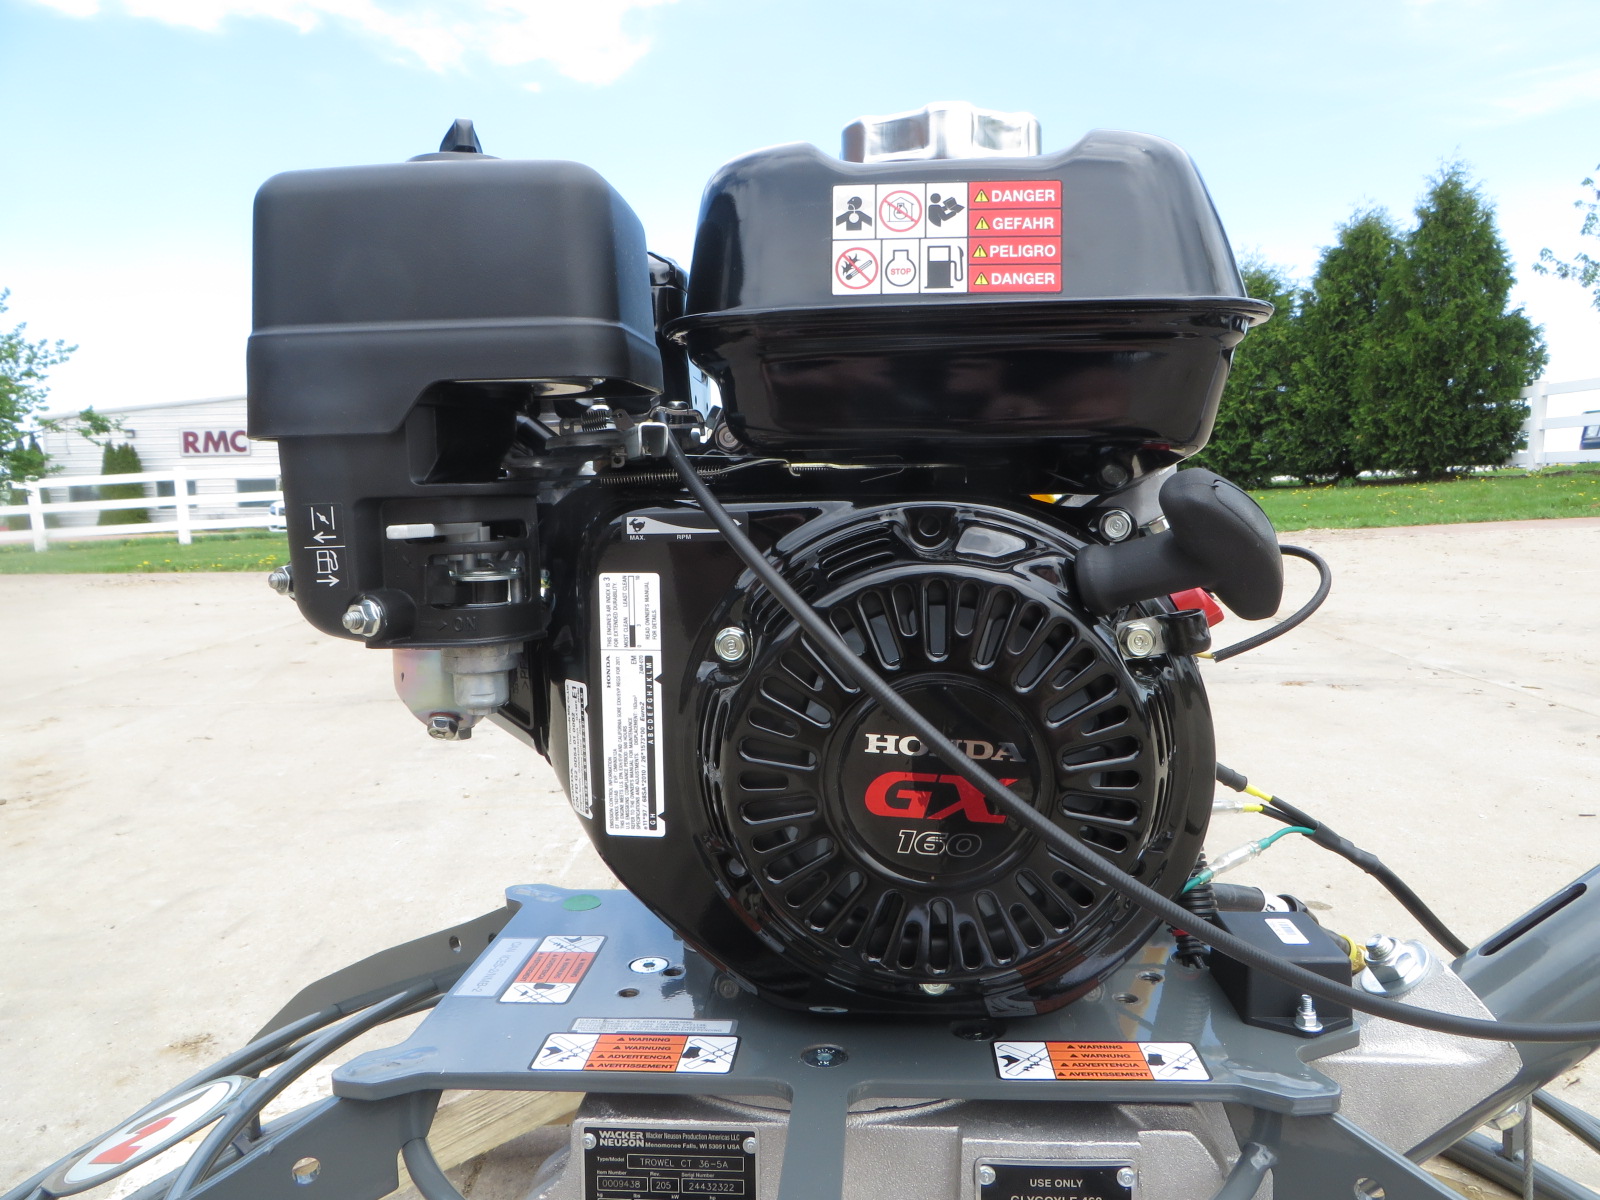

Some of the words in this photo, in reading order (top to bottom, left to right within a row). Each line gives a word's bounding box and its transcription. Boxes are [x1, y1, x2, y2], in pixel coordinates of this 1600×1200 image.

[992, 190, 1055, 202] DANGER
[992, 217, 1054, 230] GEFAHR
[990, 244, 1056, 257] PELIGRO
[991, 272, 1055, 285] DANGER
[182, 430, 247, 453] RMC
[631, 656, 637, 664] EM
[572, 686, 578, 698] E1
[864, 771, 1018, 824] GX
[897, 830, 982, 858] 160
[599, 1130, 644, 1140] WACKER
[600, 1139, 644, 1147] NEUSON
[640, 1158, 675, 1167] TROWEL
[680, 1160, 692, 1168] CT
[698, 1160, 729, 1169] 36-5A
[602, 1180, 641, 1188] 0009438
[656, 1182, 672, 1190] 205
[688, 1182, 735, 1192] 24432322
[1030, 1179, 1052, 1187] USE
[1054, 1179, 1083, 1188] ONLY
